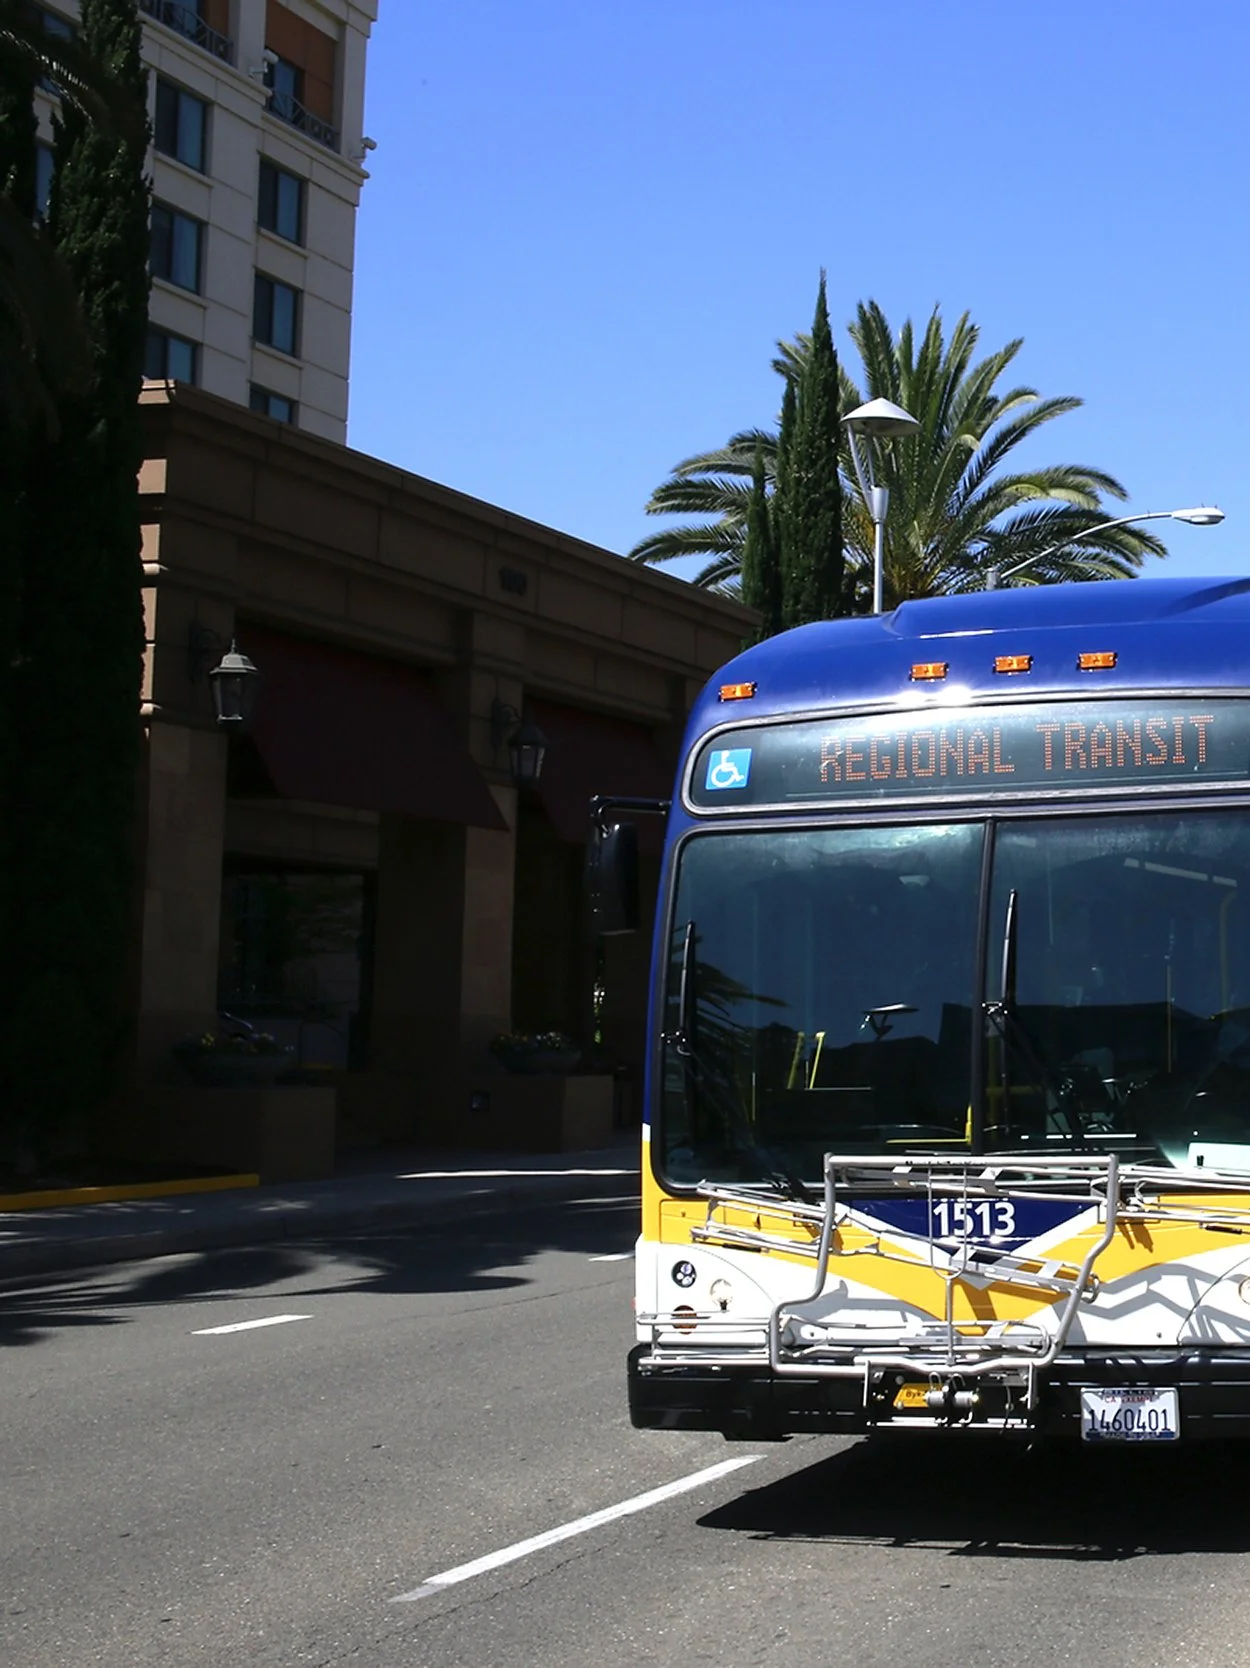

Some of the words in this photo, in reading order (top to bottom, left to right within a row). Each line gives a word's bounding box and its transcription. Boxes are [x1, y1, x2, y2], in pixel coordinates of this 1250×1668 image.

[820, 726, 1015, 783] REGIONAL
[1035, 714, 1215, 771] TRANSIT
[933, 1200, 1016, 1236] 1513
[1088, 1408, 1171, 1432] 1460401
